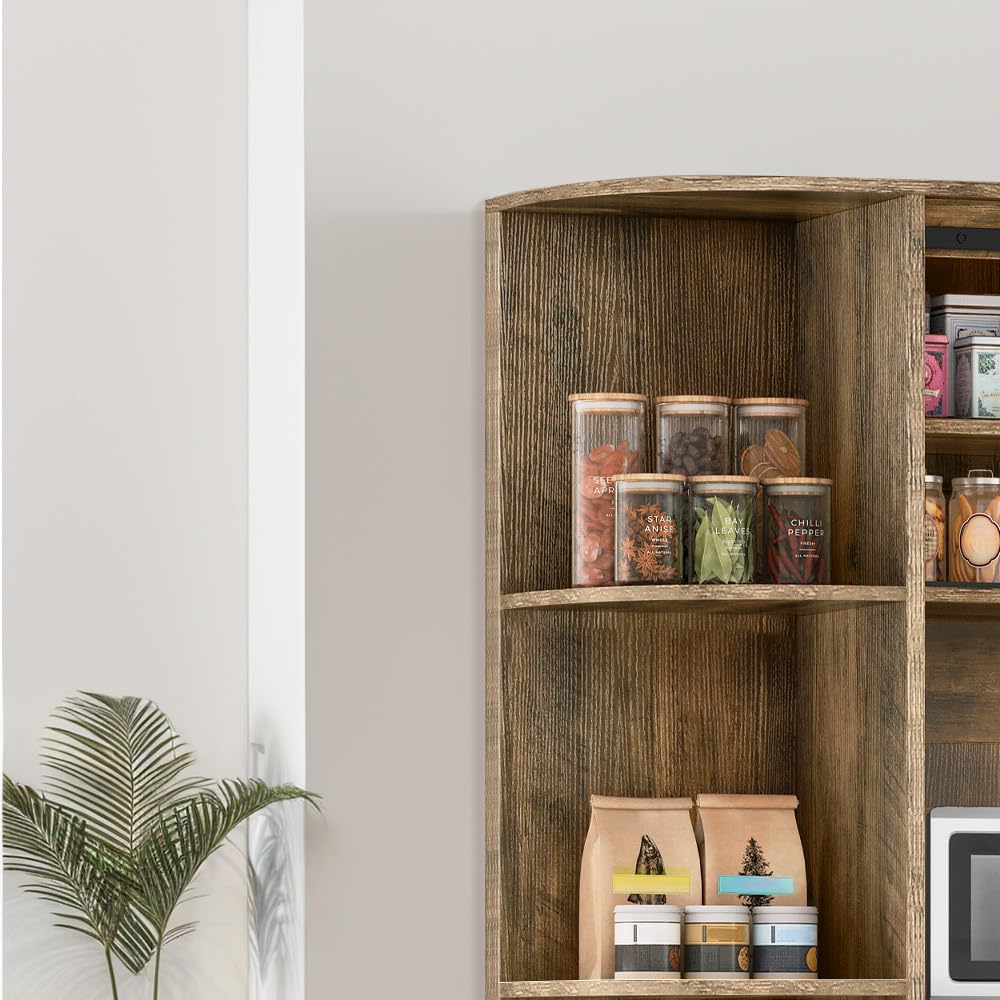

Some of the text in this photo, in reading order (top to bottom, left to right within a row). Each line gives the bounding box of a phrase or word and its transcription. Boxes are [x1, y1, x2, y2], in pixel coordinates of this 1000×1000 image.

[593, 476, 612, 484] SEE
[593, 486, 615, 494] APR
[647, 515, 672, 523] STAR
[724, 517, 744, 525] BAY
[790, 519, 823, 527] CHILLI
[644, 525, 674, 533] ANISE
[715, 527, 750, 535] LEAVES
[787, 528, 825, 537] PEPPER
